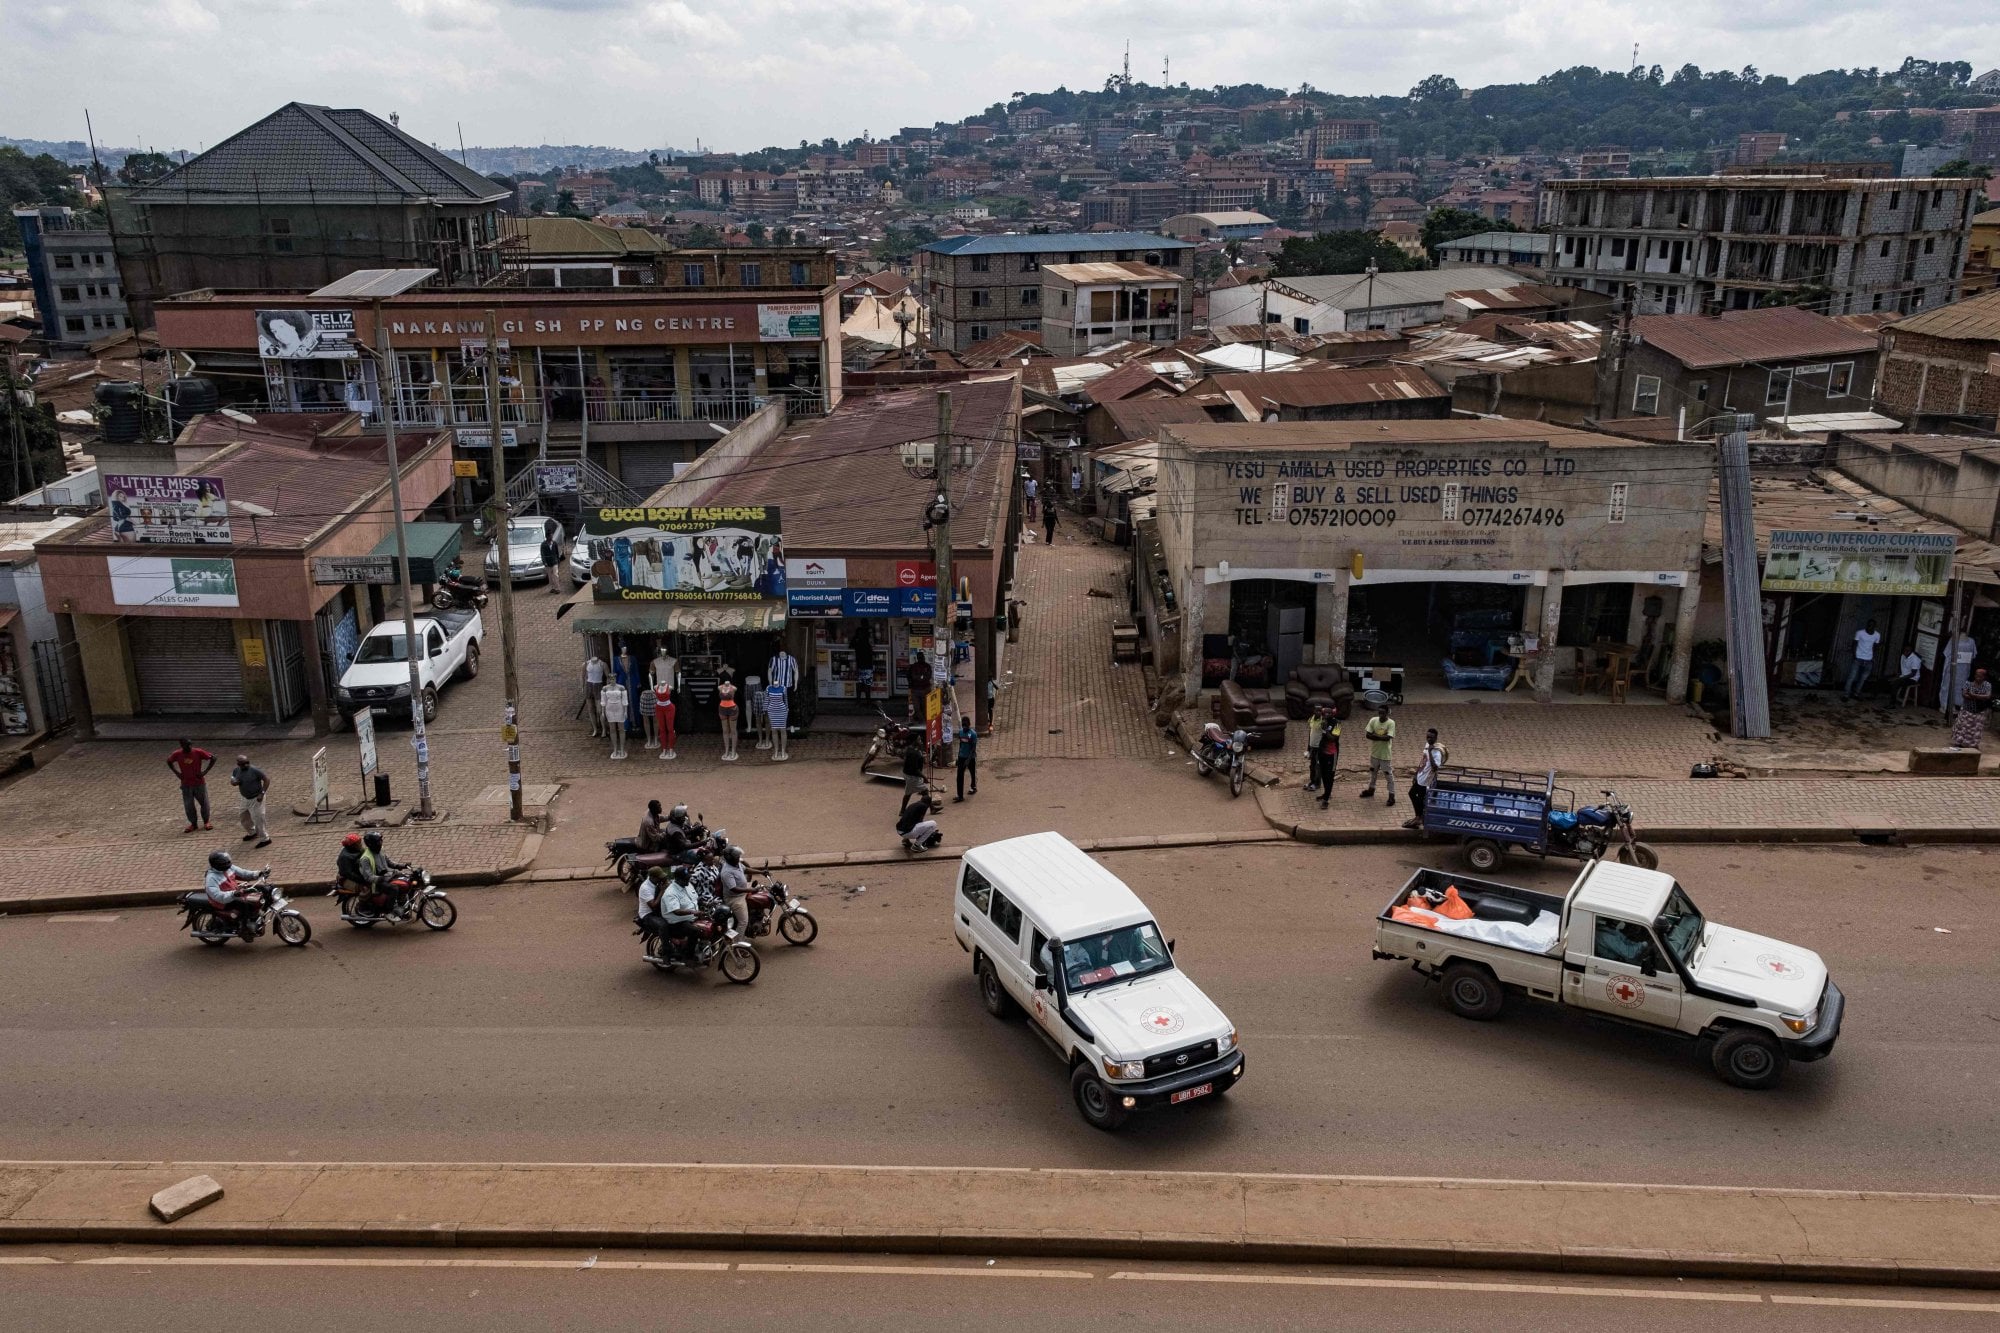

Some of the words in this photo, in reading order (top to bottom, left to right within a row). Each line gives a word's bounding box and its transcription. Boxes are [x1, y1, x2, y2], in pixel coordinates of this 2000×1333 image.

[312, 314, 352, 325] FELIZ
[655, 318, 735, 330] CENTRE
[1226, 461, 1264, 478] YESU
[1278, 461, 1335, 478] AMALA
[1345, 460, 1384, 478] USED
[1396, 460, 1491, 477] PROPERTIES
[1543, 458, 1576, 475] LTD
[120, 476, 163, 489] LITTLE
[168, 478, 200, 490] MISS
[135, 489, 187, 498] BEAUTY
[1240, 487, 1262, 504] WE
[1294, 487, 1326, 504] BUY
[1335, 486, 1345, 503] &
[1356, 487, 1394, 504] SELL
[1400, 486, 1440, 503] USED
[1461, 486, 1518, 503] THINGS
[600, 509, 644, 521] GUCCI
[647, 508, 688, 520] BODY
[692, 508, 766, 520] FASHIONS
[1289, 509, 1396, 527] 0757210009
[1462, 508, 1564, 526] 0774267496
[1772, 532, 1824, 544] MUNNO
[1827, 533, 1890, 545] INTERIOR
[1892, 534, 1953, 547] CURTAINS
[1790, 582, 1816, 590] 0701
[1819, 583, 1837, 591] 542
[1867, 584, 1893, 592] 0784
[622, 590, 662, 600] Contact
[824, 594, 842, 602] Agent
[1447, 819, 1515, 833] ZONGSHEN
